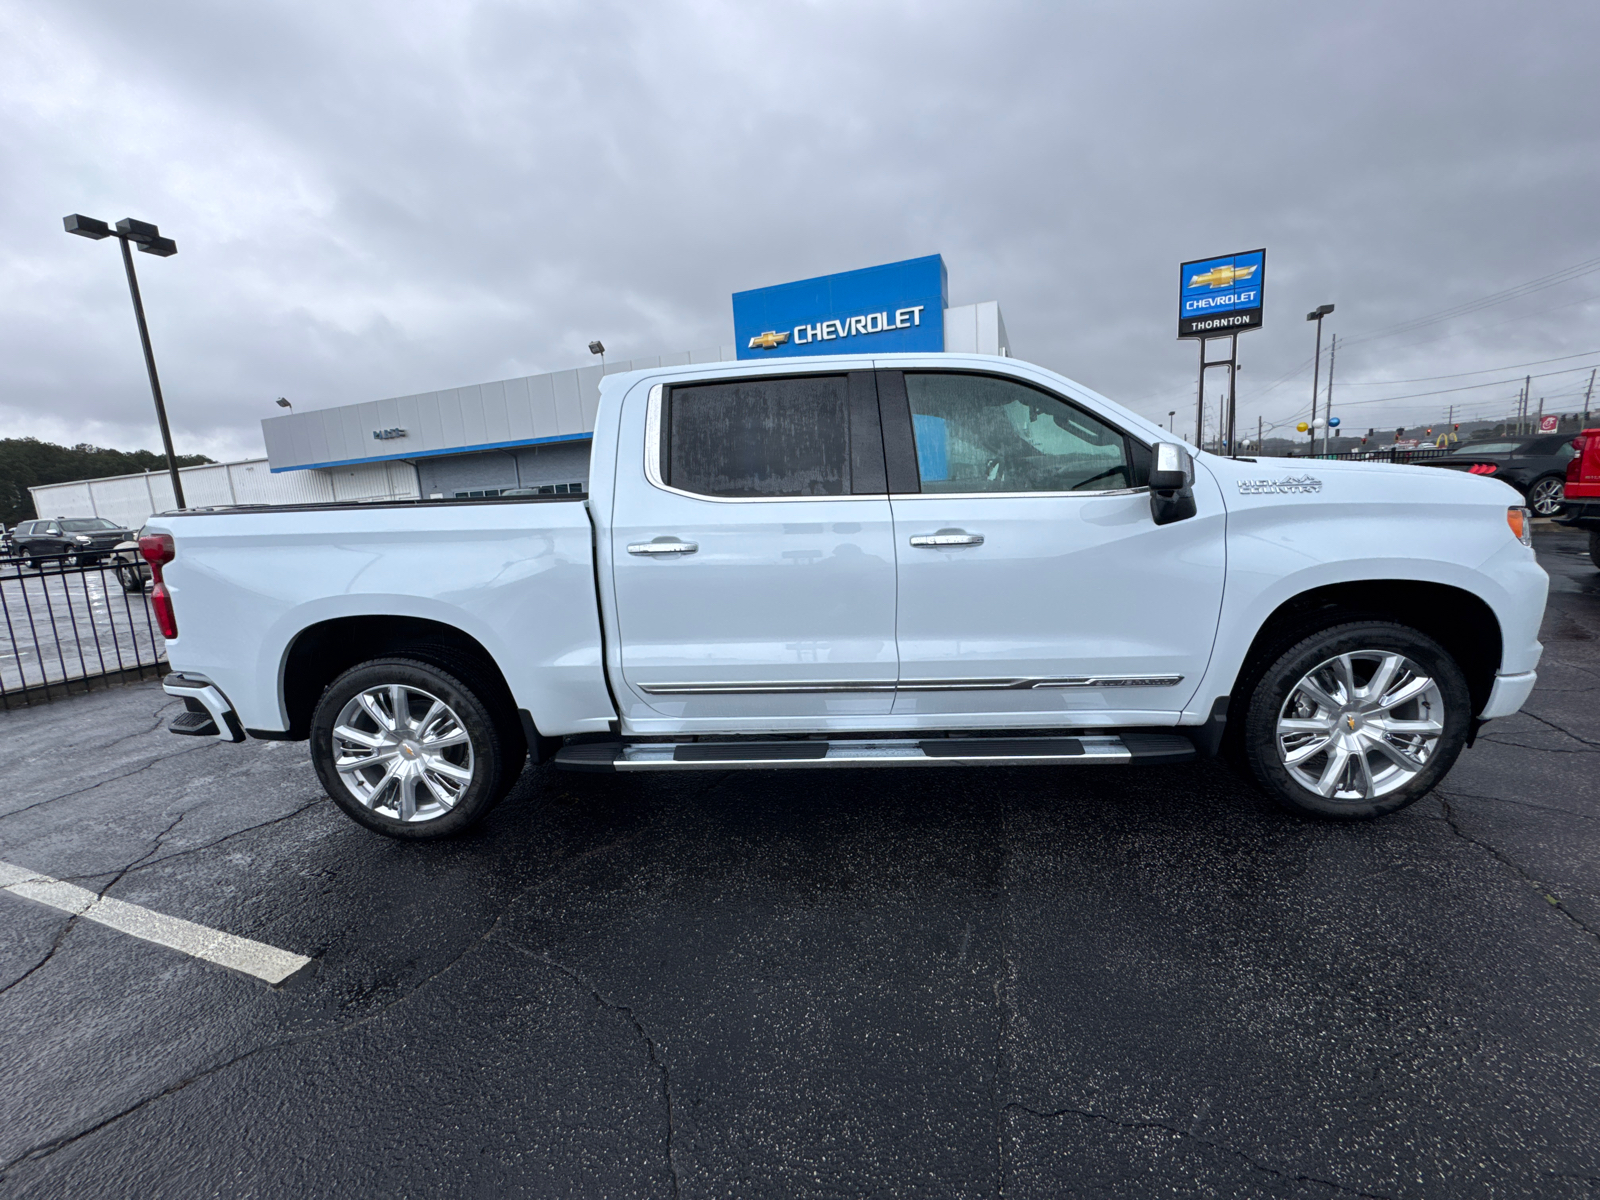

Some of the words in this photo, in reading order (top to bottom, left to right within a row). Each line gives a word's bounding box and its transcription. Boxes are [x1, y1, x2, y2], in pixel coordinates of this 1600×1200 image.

[1186, 291, 1256, 310] CHEVROLET
[793, 305, 924, 345] CHEVROLET
[1191, 315, 1250, 331] THORNTON
